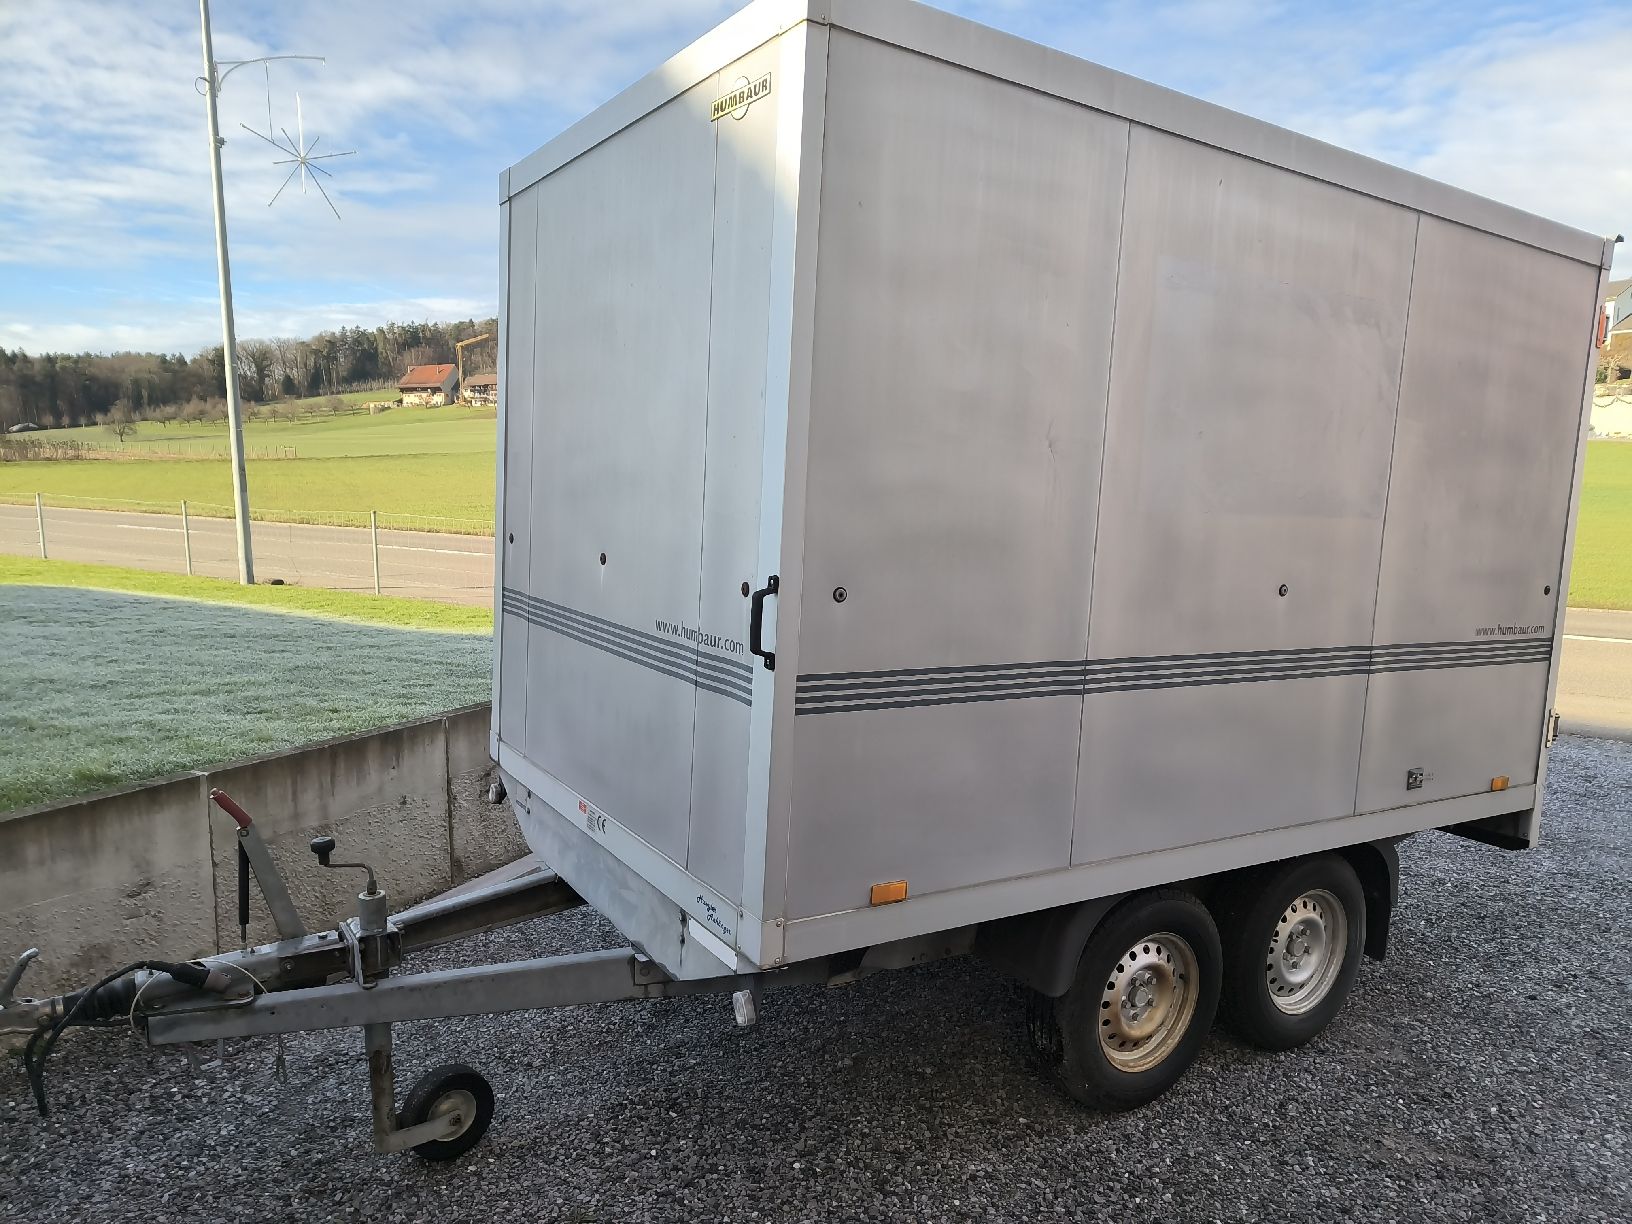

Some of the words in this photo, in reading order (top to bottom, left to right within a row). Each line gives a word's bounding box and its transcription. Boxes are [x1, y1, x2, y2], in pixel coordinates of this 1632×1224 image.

[712, 78, 768, 118] HUMBAUR
[655, 619, 744, 655] www.humbaur.com
[1476, 624, 1545, 637] www.humbaur.com
